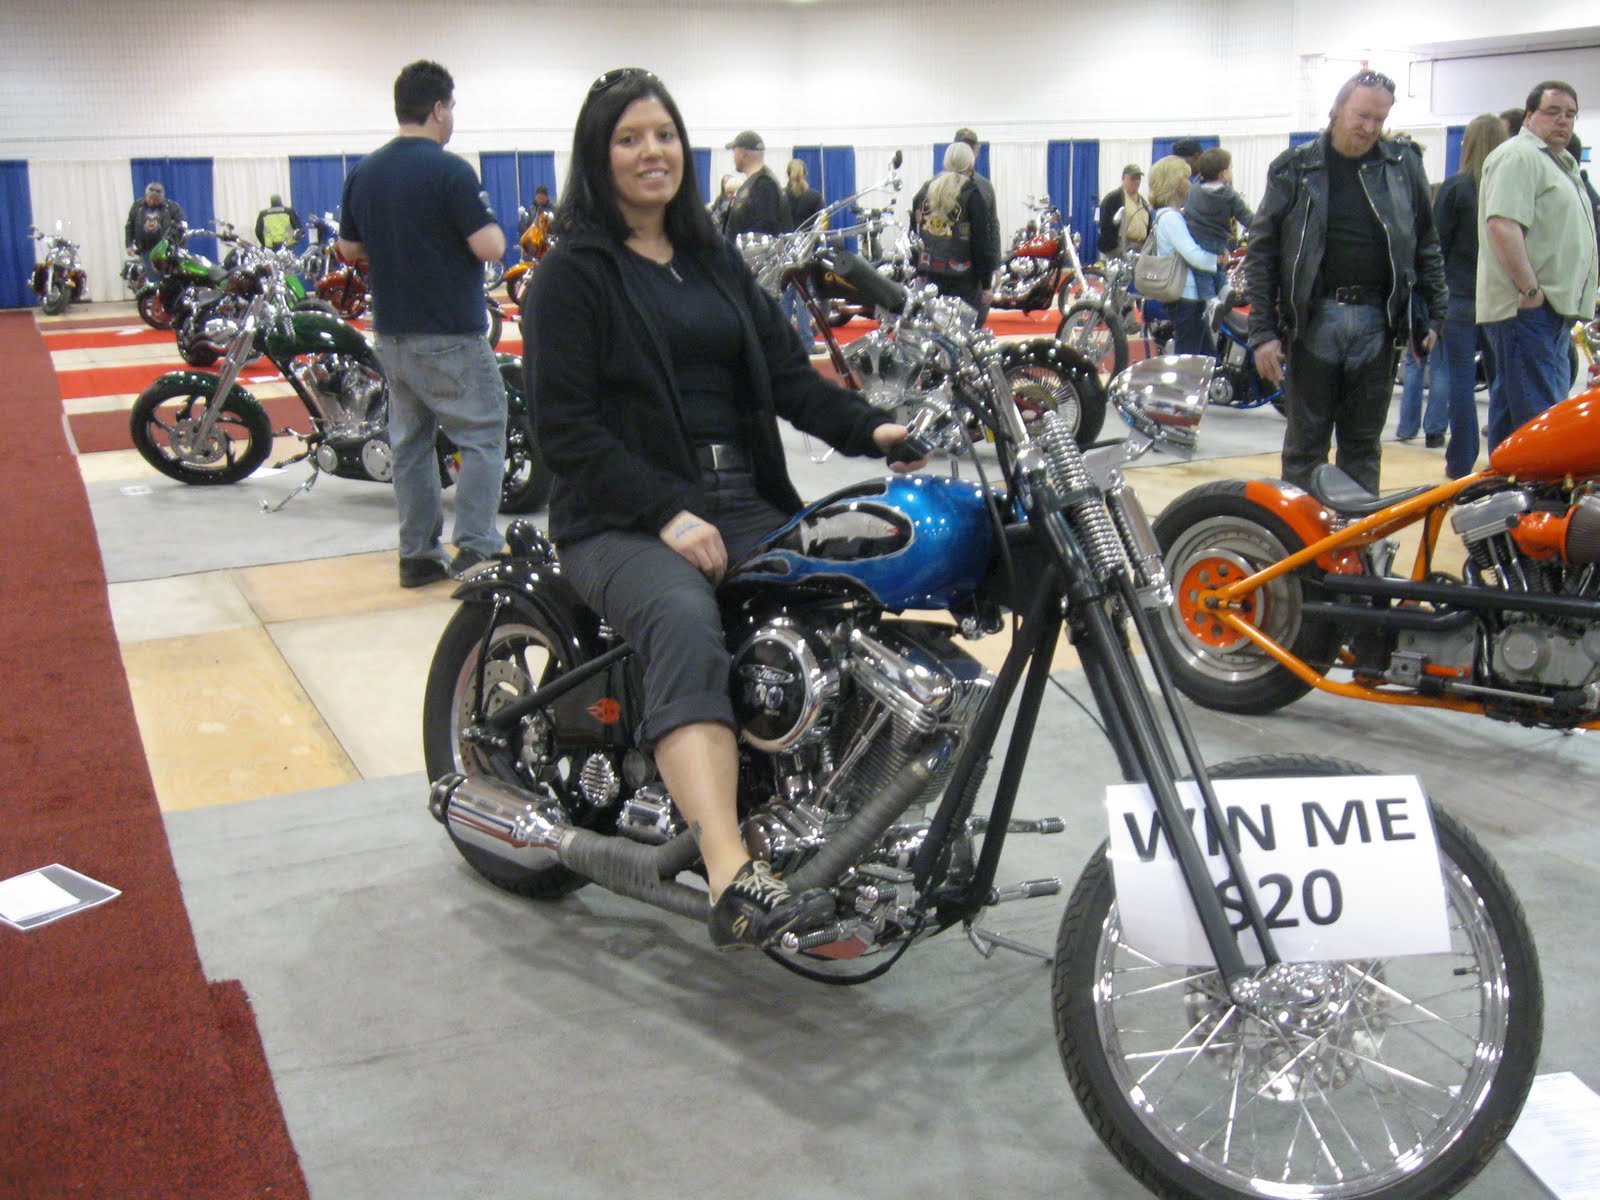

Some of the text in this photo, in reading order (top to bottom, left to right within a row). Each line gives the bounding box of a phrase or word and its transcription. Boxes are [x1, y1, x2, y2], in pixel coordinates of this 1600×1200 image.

[1123, 797, 1417, 863] WIN ME
[1214, 868, 1344, 942] $20
